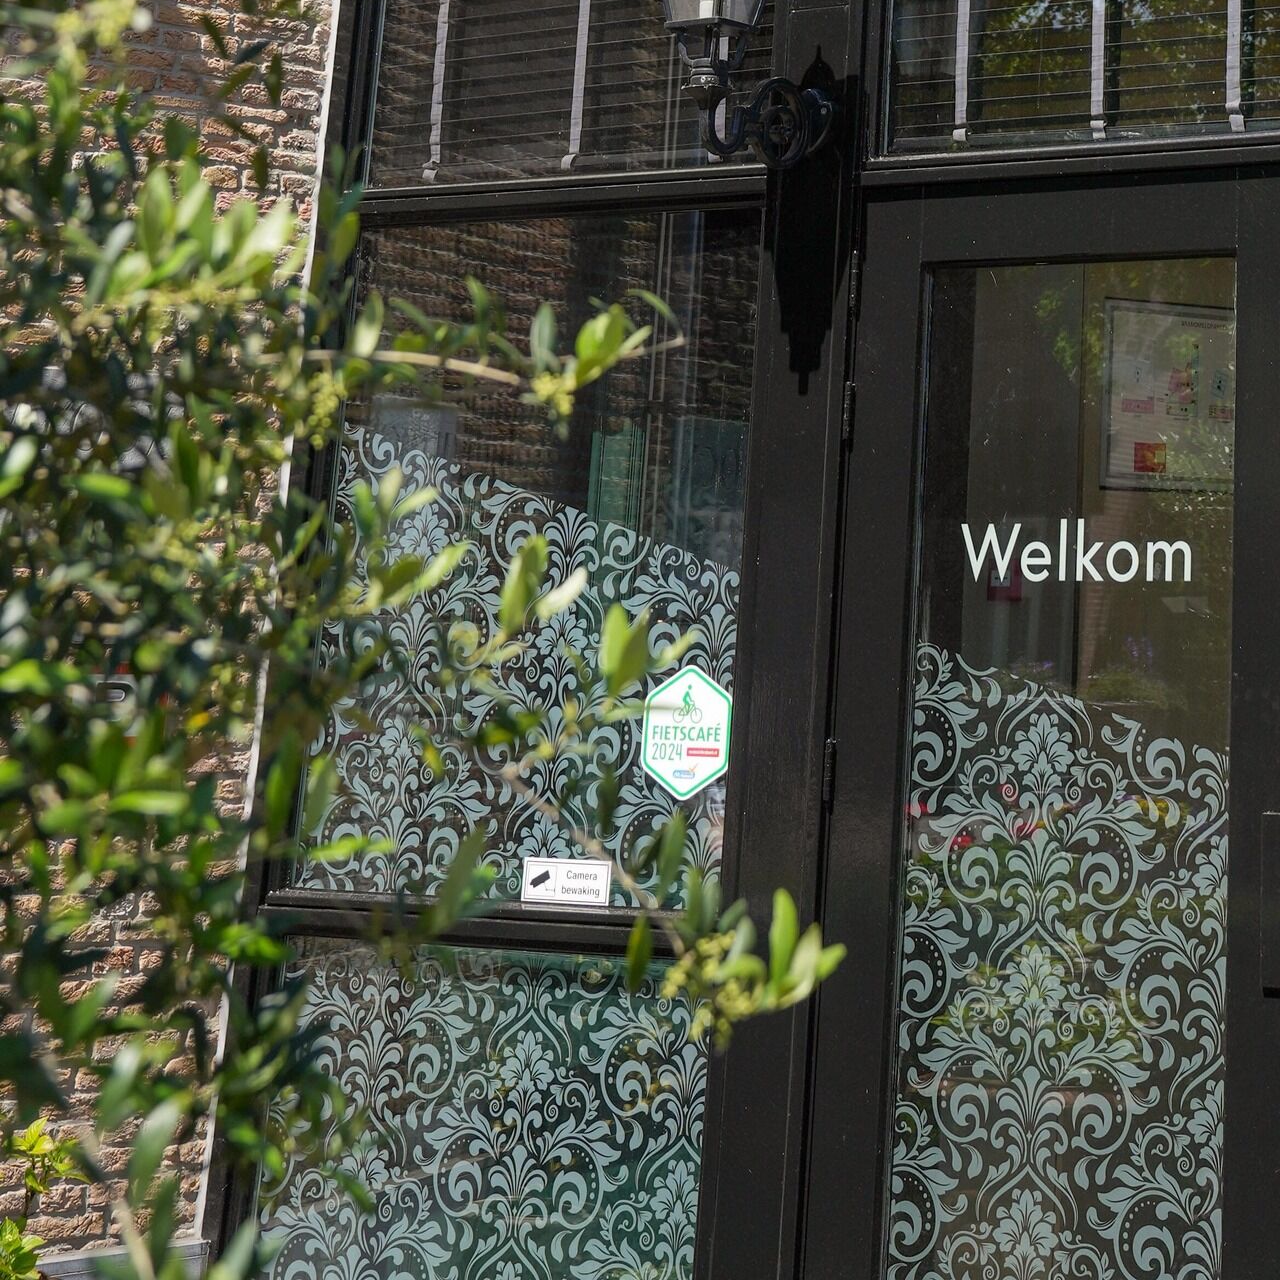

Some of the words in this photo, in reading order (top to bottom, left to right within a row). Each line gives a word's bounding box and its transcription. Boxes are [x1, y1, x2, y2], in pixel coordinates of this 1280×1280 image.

[960, 518, 1193, 583] Welkom
[652, 723, 721, 742] FIETSCAFÉ
[652, 743, 683, 761] 2024
[566, 870, 598, 881] Camera
[561, 885, 600, 899] bewaking
